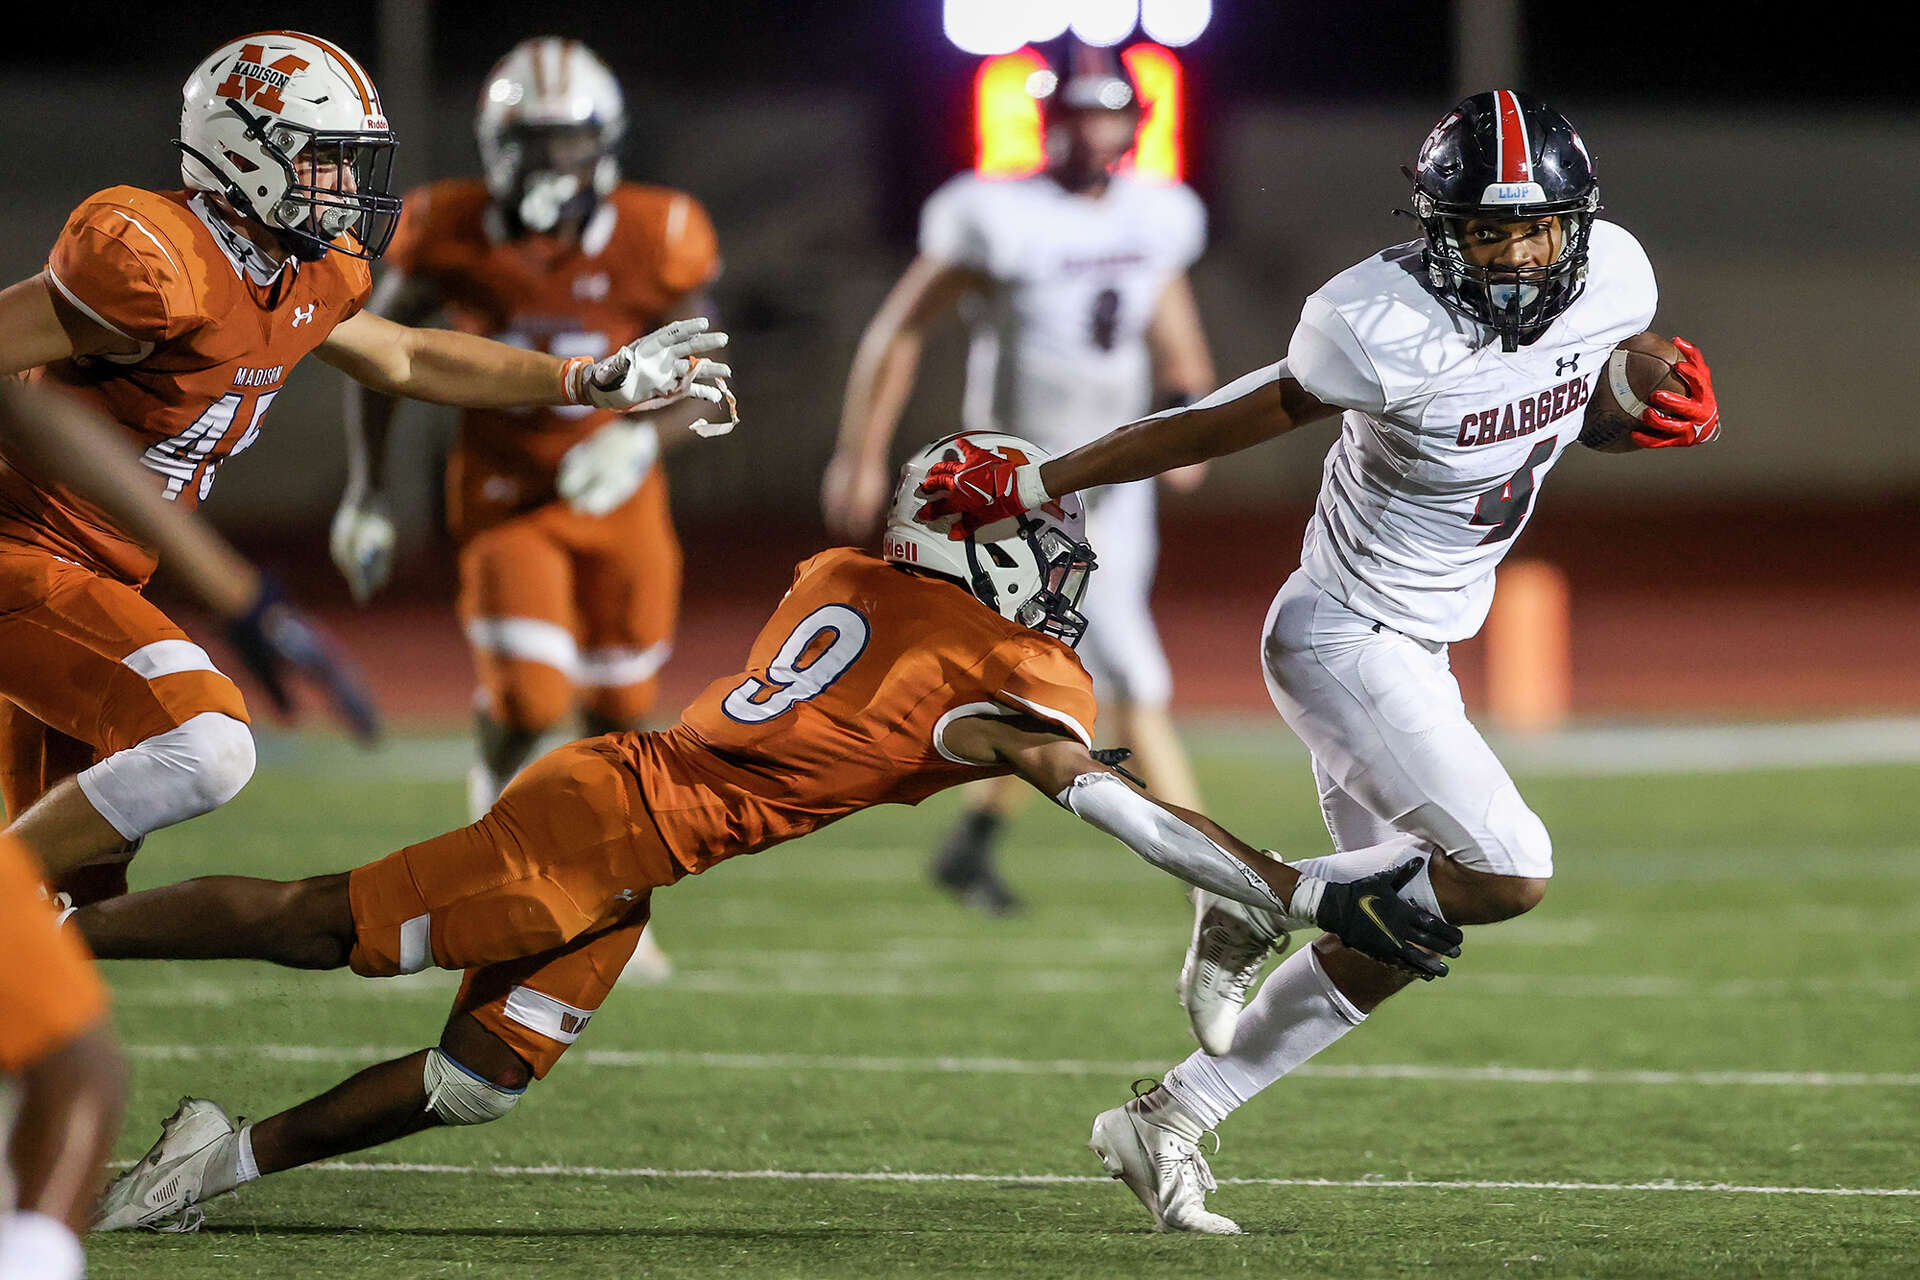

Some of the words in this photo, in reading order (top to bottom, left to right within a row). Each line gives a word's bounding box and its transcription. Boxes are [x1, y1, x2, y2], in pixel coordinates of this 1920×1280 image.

[231, 61, 290, 89] MADISON
[233, 365, 284, 387] MADISON
[1469, 434, 1558, 547] 4
[721, 602, 871, 725] 9
